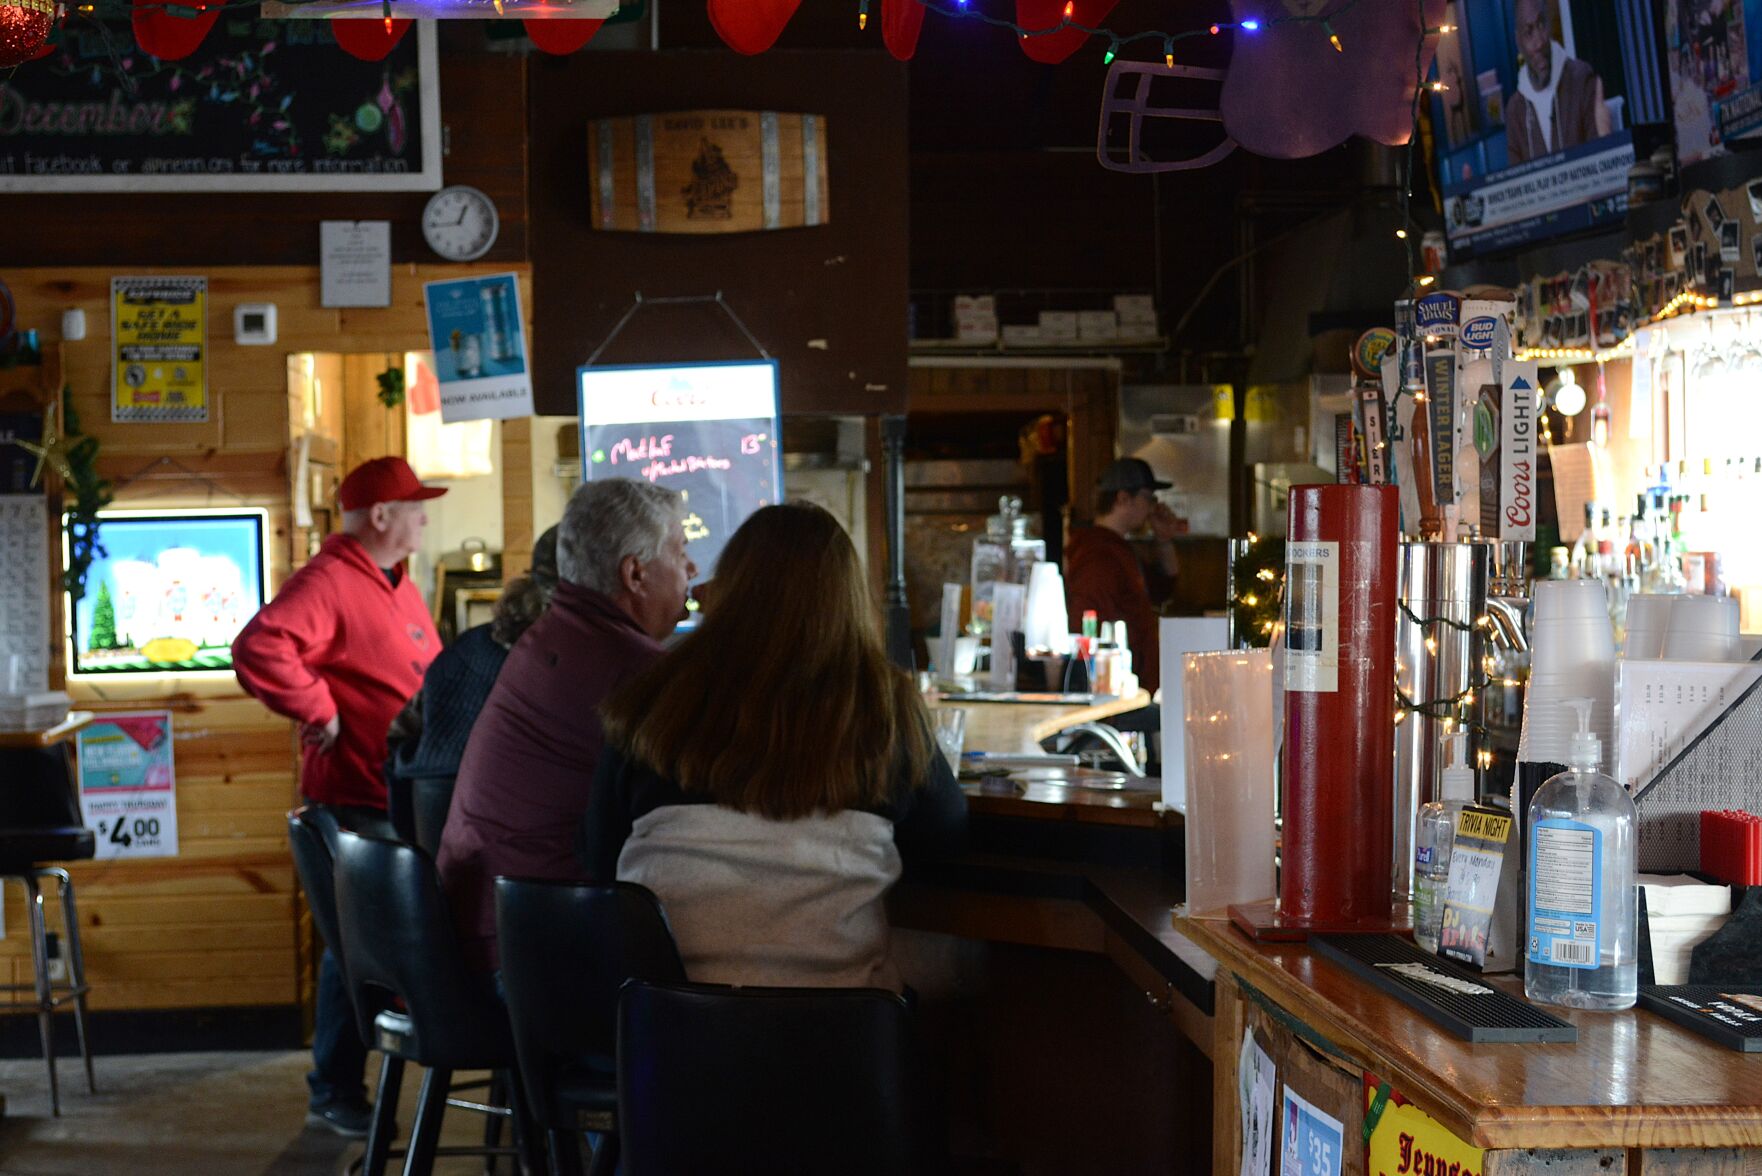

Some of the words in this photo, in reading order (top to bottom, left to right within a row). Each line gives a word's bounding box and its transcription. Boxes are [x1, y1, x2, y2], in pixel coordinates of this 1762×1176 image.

[1419, 300, 1457, 314] SAMUEL
[1420, 308, 1454, 322] ADAMS
[1470, 322, 1494, 332] BUD
[440, 393, 467, 407] NOW
[468, 387, 529, 405] AVAILABLE
[1432, 358, 1455, 427] WINTER
[1513, 392, 1530, 455] LIGHT
[1437, 430, 1453, 490] LAGER
[1506, 459, 1531, 530] Coors
[1460, 812, 1483, 835] TRIVIA
[1483, 817, 1509, 839] NIGHT
